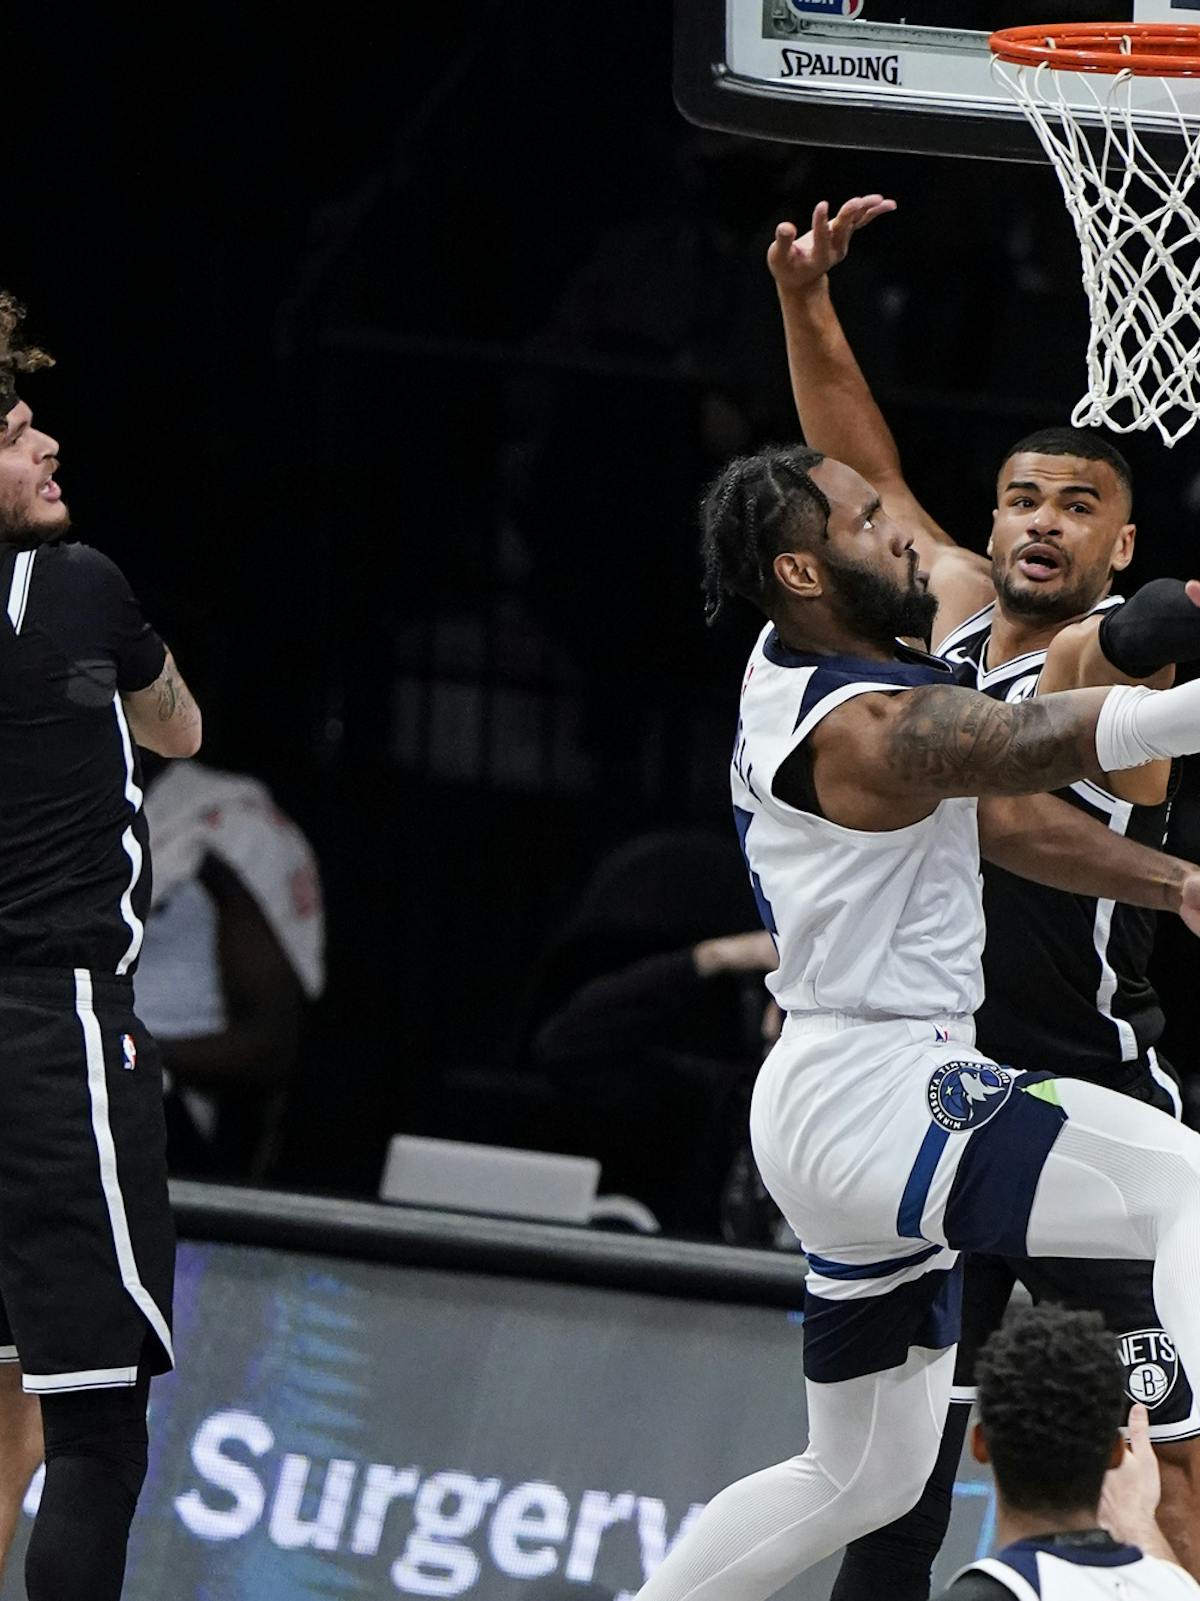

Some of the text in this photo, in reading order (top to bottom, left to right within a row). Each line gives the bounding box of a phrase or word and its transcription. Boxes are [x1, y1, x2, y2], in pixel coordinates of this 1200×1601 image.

[780, 47, 899, 85] SPALDING
[928, 1078, 961, 1129] MINNESOTA
[1117, 1332, 1175, 1367] NETS
[1142, 1369, 1156, 1396] B
